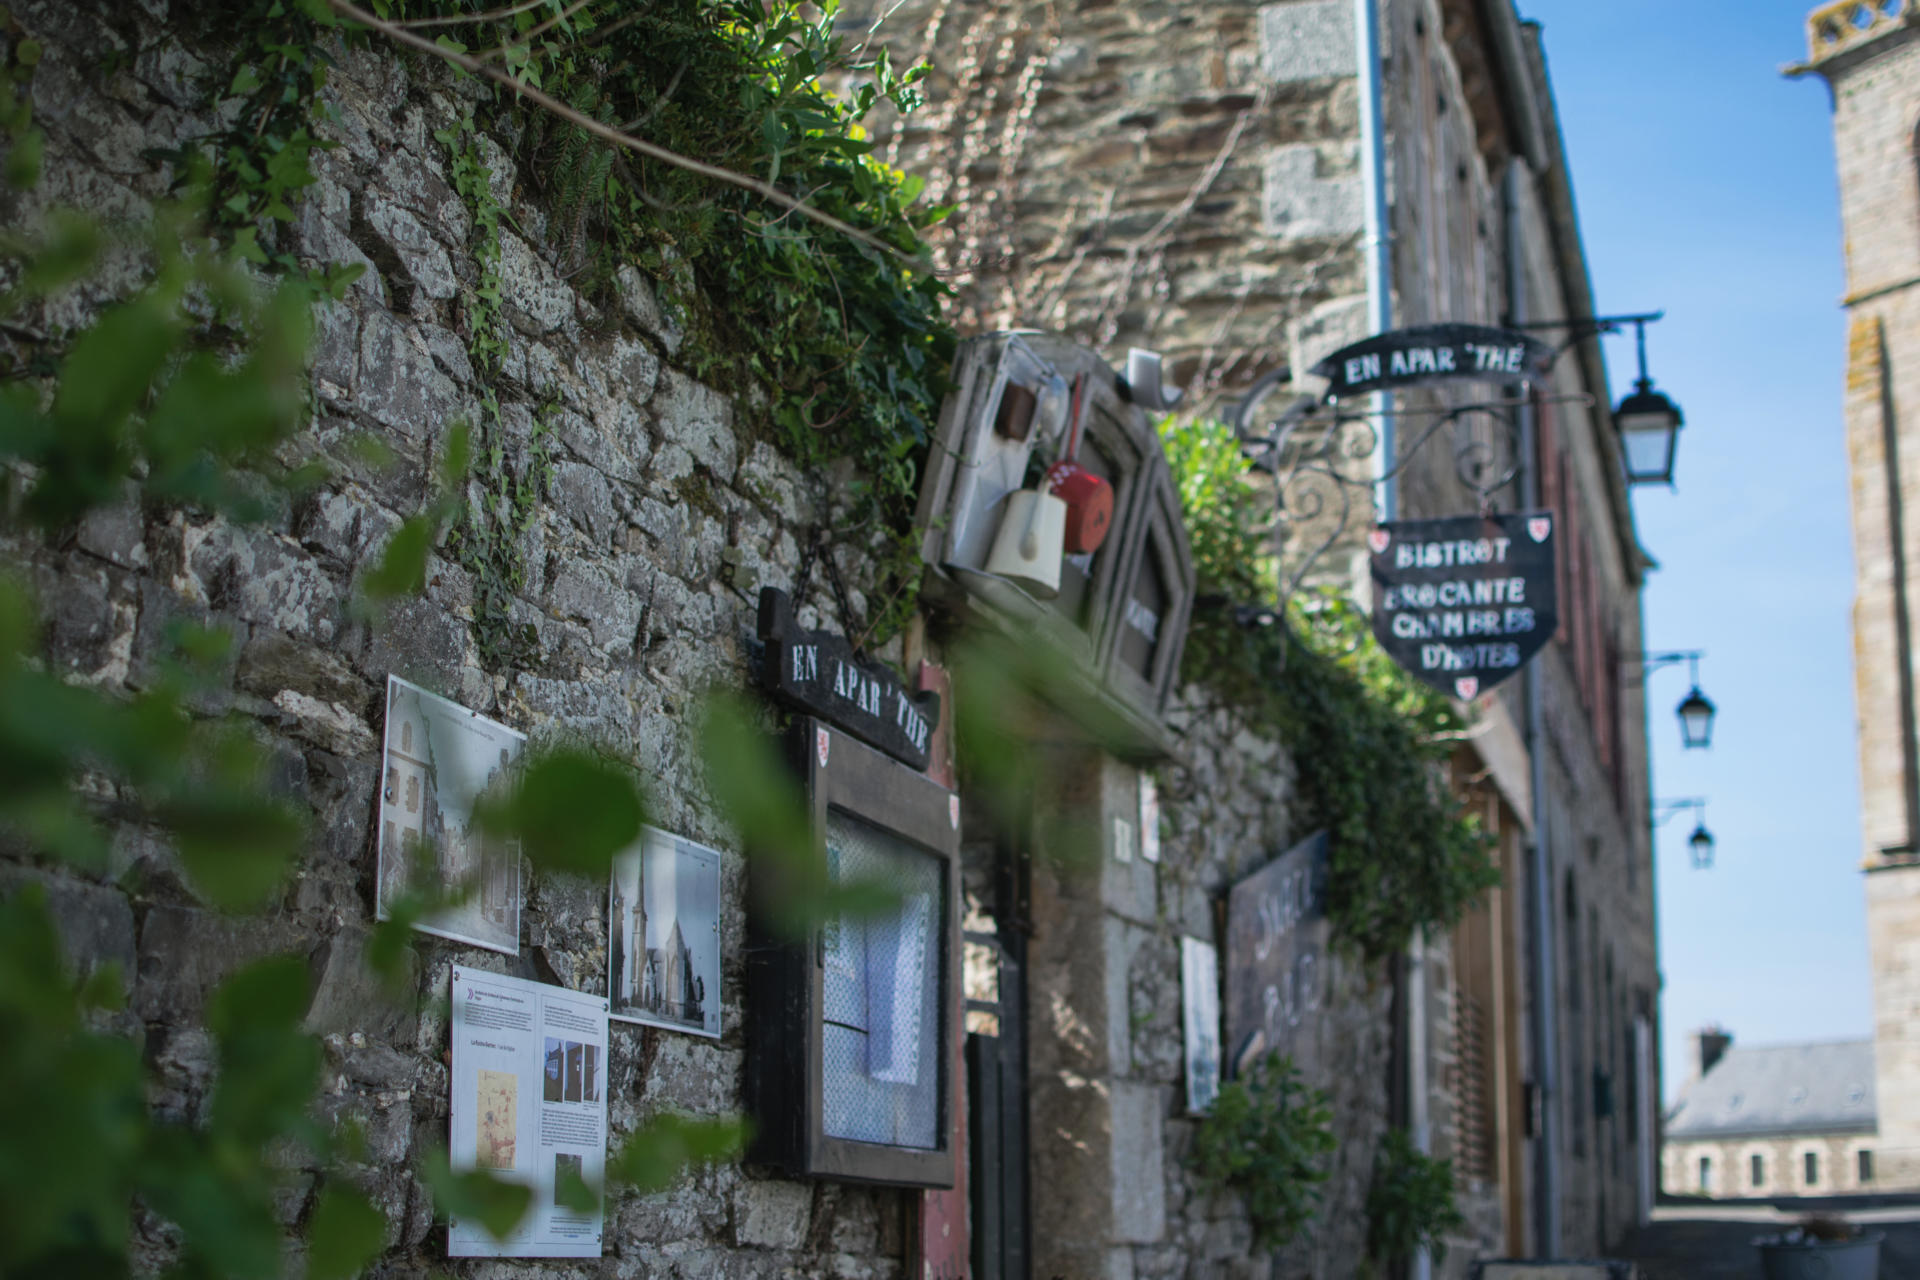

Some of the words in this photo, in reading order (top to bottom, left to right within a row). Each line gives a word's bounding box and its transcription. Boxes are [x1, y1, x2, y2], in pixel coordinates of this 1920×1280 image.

[1344, 352, 1382, 384] EN
[1390, 345, 1456, 376] APAR
[1395, 537, 1511, 569] BISTROT
[1384, 576, 1526, 610] BROCANTE
[1392, 606, 1535, 639] CHAMBRES
[792, 645, 818, 682] EN
